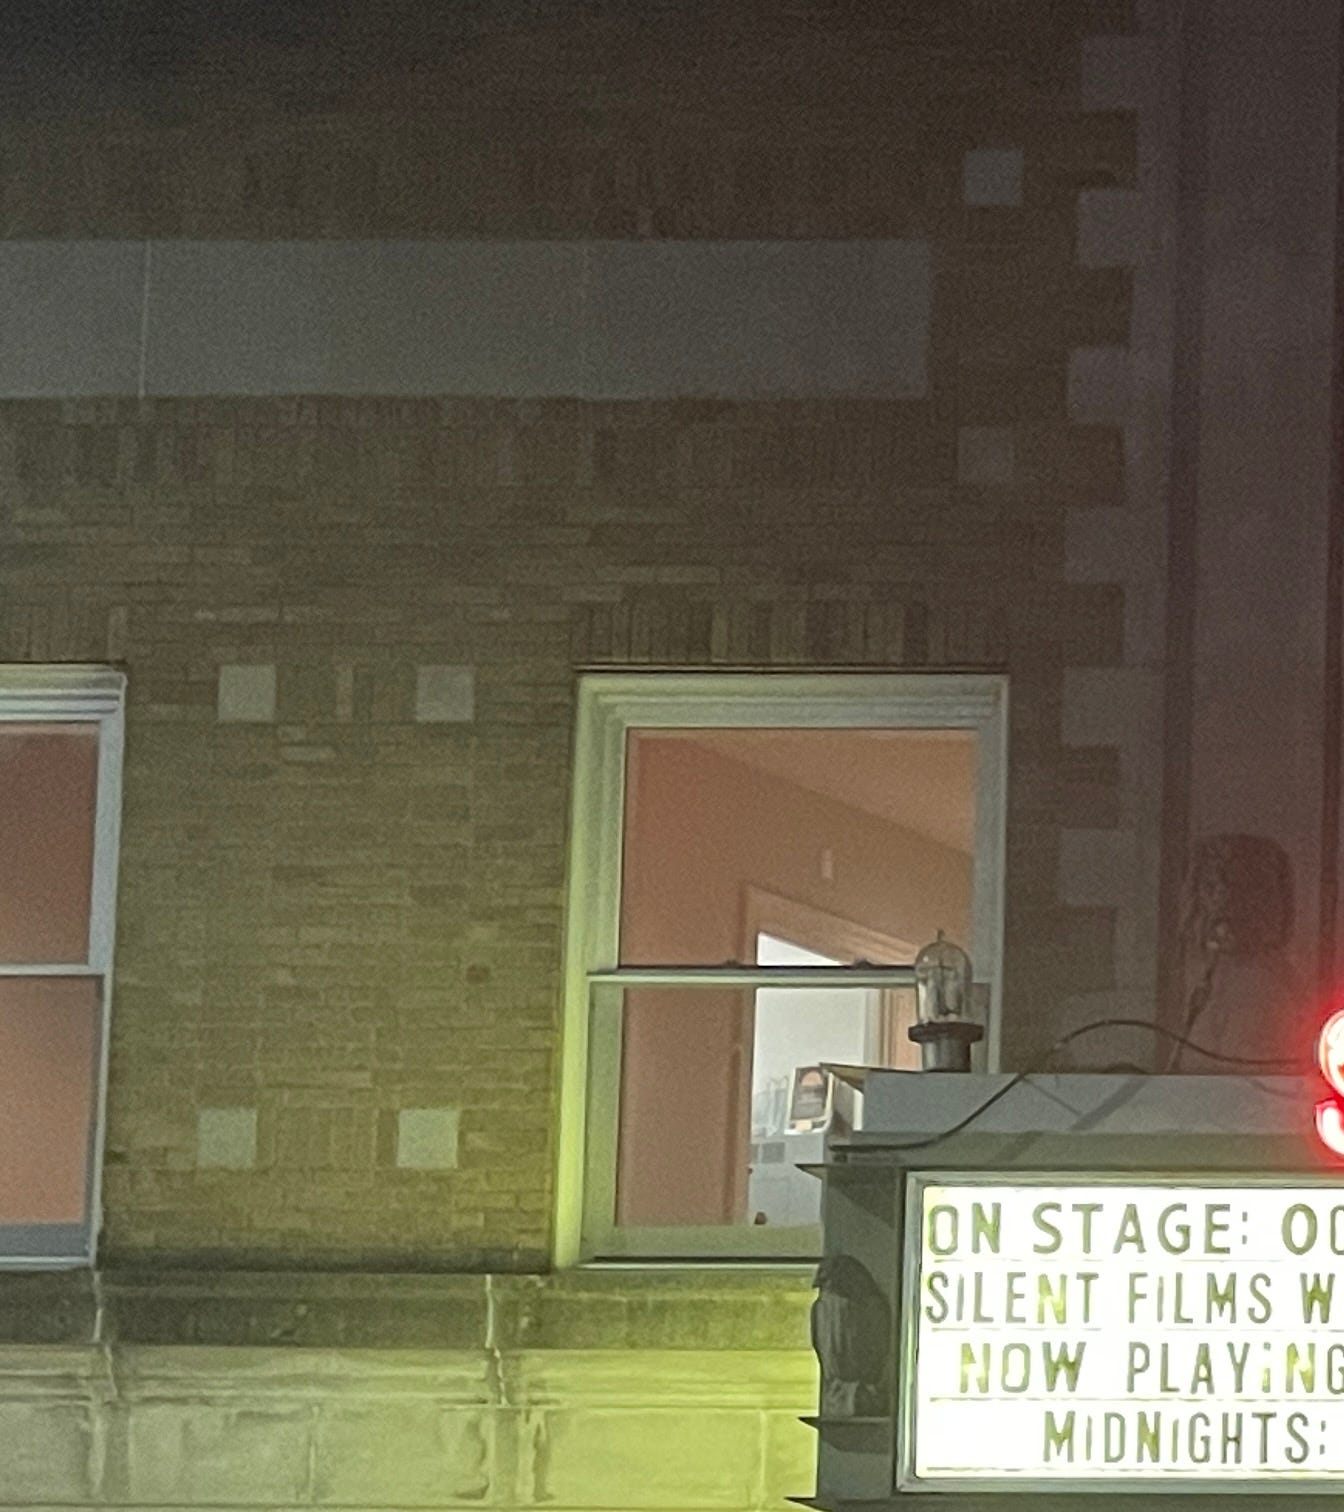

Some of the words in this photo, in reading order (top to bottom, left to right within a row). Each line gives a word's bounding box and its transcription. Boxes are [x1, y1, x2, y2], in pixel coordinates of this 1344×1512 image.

[926, 1202, 1003, 1256] ON
[1032, 1202, 1249, 1256] STAGE:
[924, 1270, 1100, 1325] SILENT
[1127, 1272, 1273, 1324] FILMS
[959, 1341, 1087, 1396] NOW
[1042, 1410, 1327, 1465] MIDNIGHTS:
